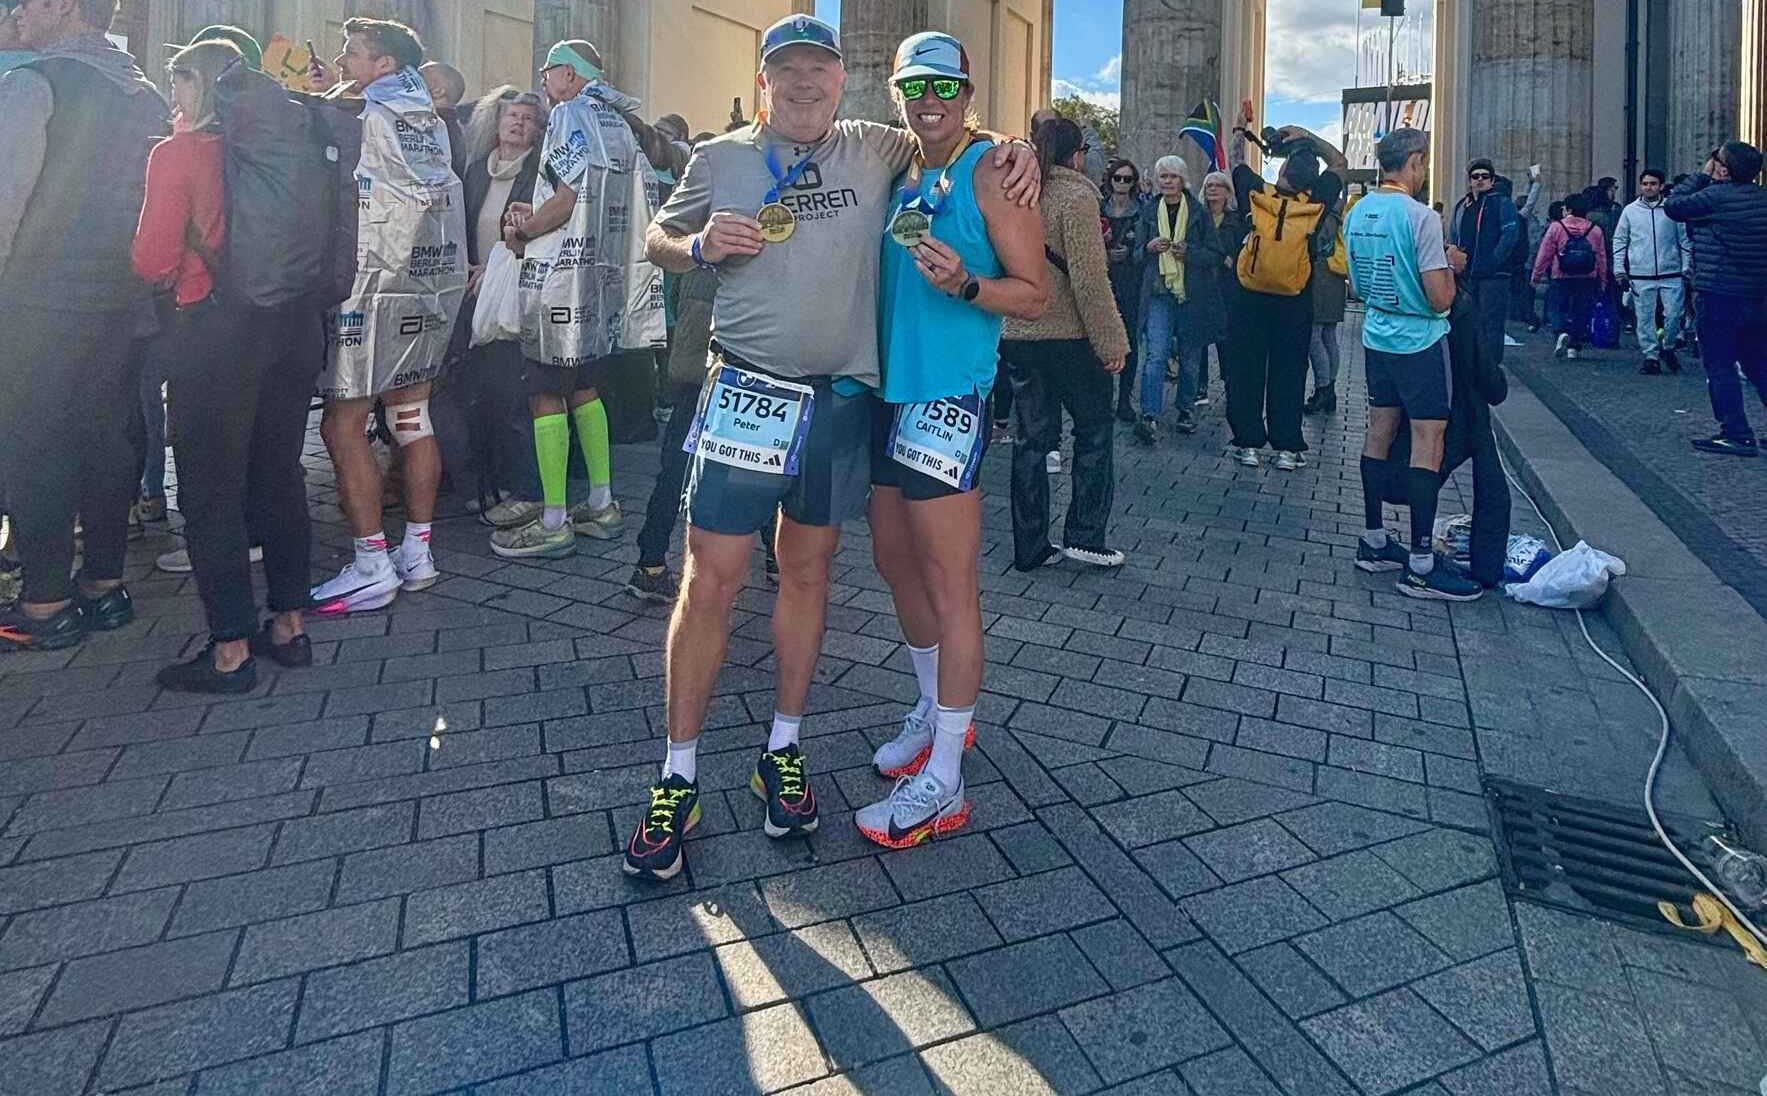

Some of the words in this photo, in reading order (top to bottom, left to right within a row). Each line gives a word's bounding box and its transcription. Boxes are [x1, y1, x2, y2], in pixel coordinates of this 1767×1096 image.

[549, 143, 570, 162] MW
[781, 188, 858, 213] ERREN
[411, 245, 443, 259] BMW
[561, 237, 584, 249] MW
[718, 388, 788, 423] 51784
[910, 400, 972, 434] 1589
[733, 417, 760, 431] Peter
[916, 420, 953, 442] CAITLIN
[701, 438, 718, 453] YOU
[719, 445, 737, 458] GOT
[738, 449, 761, 464] THIS
[907, 447, 921, 462] GOT
[922, 453, 943, 471] THIS
